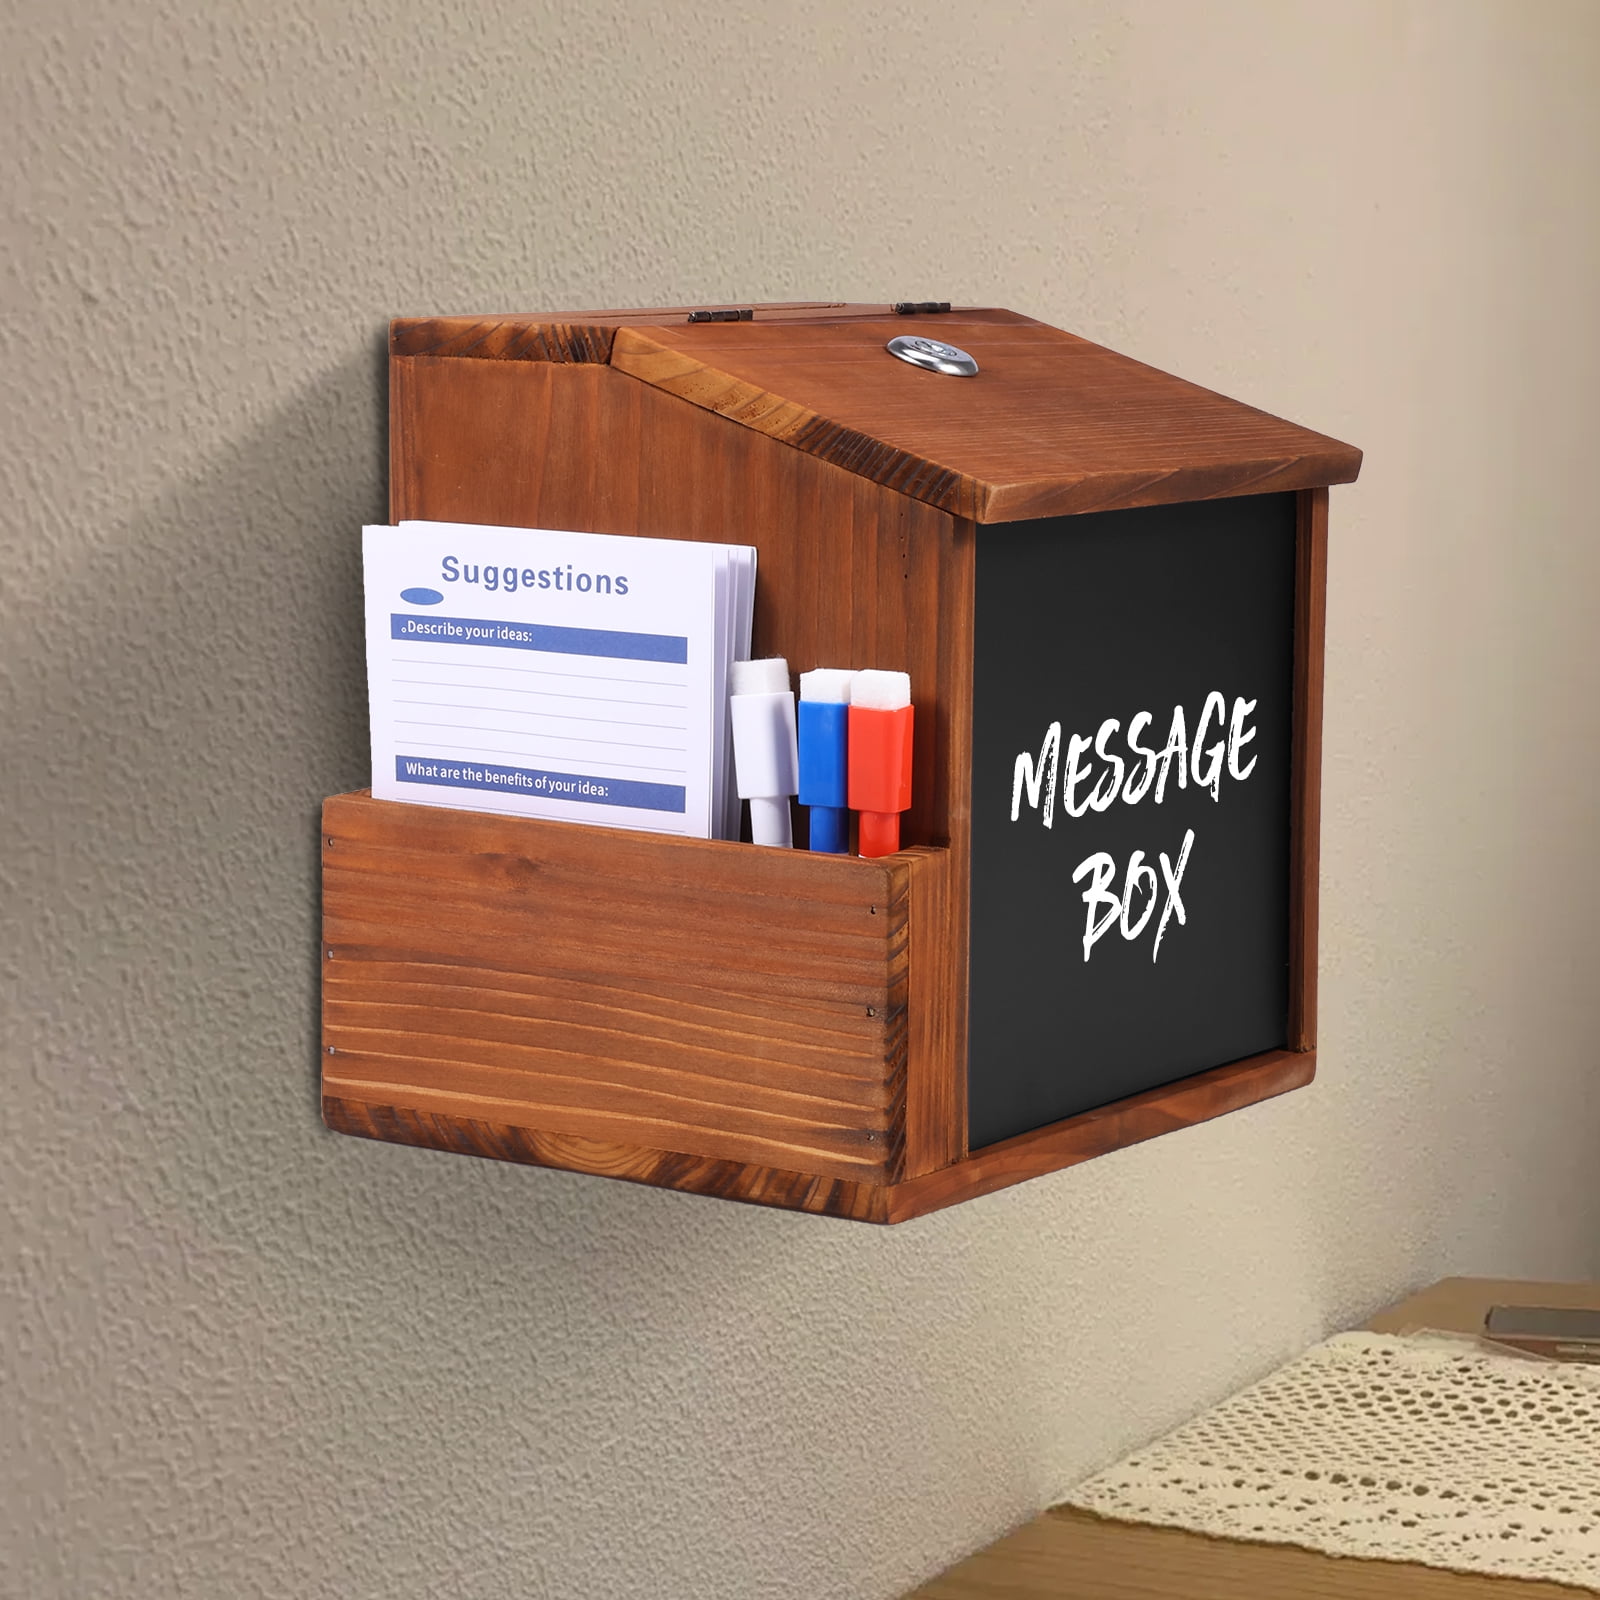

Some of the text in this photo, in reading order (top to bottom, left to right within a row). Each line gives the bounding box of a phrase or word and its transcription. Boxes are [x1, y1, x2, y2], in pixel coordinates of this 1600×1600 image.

[441, 555, 629, 595] Suggestions
[463, 625, 495, 640] your
[497, 625, 533, 642] ideas:
[405, 761, 609, 797] What are the benefits of your idea:
[1010, 690, 1258, 829] MESSAGE
[1072, 828, 1195, 964] BOX
